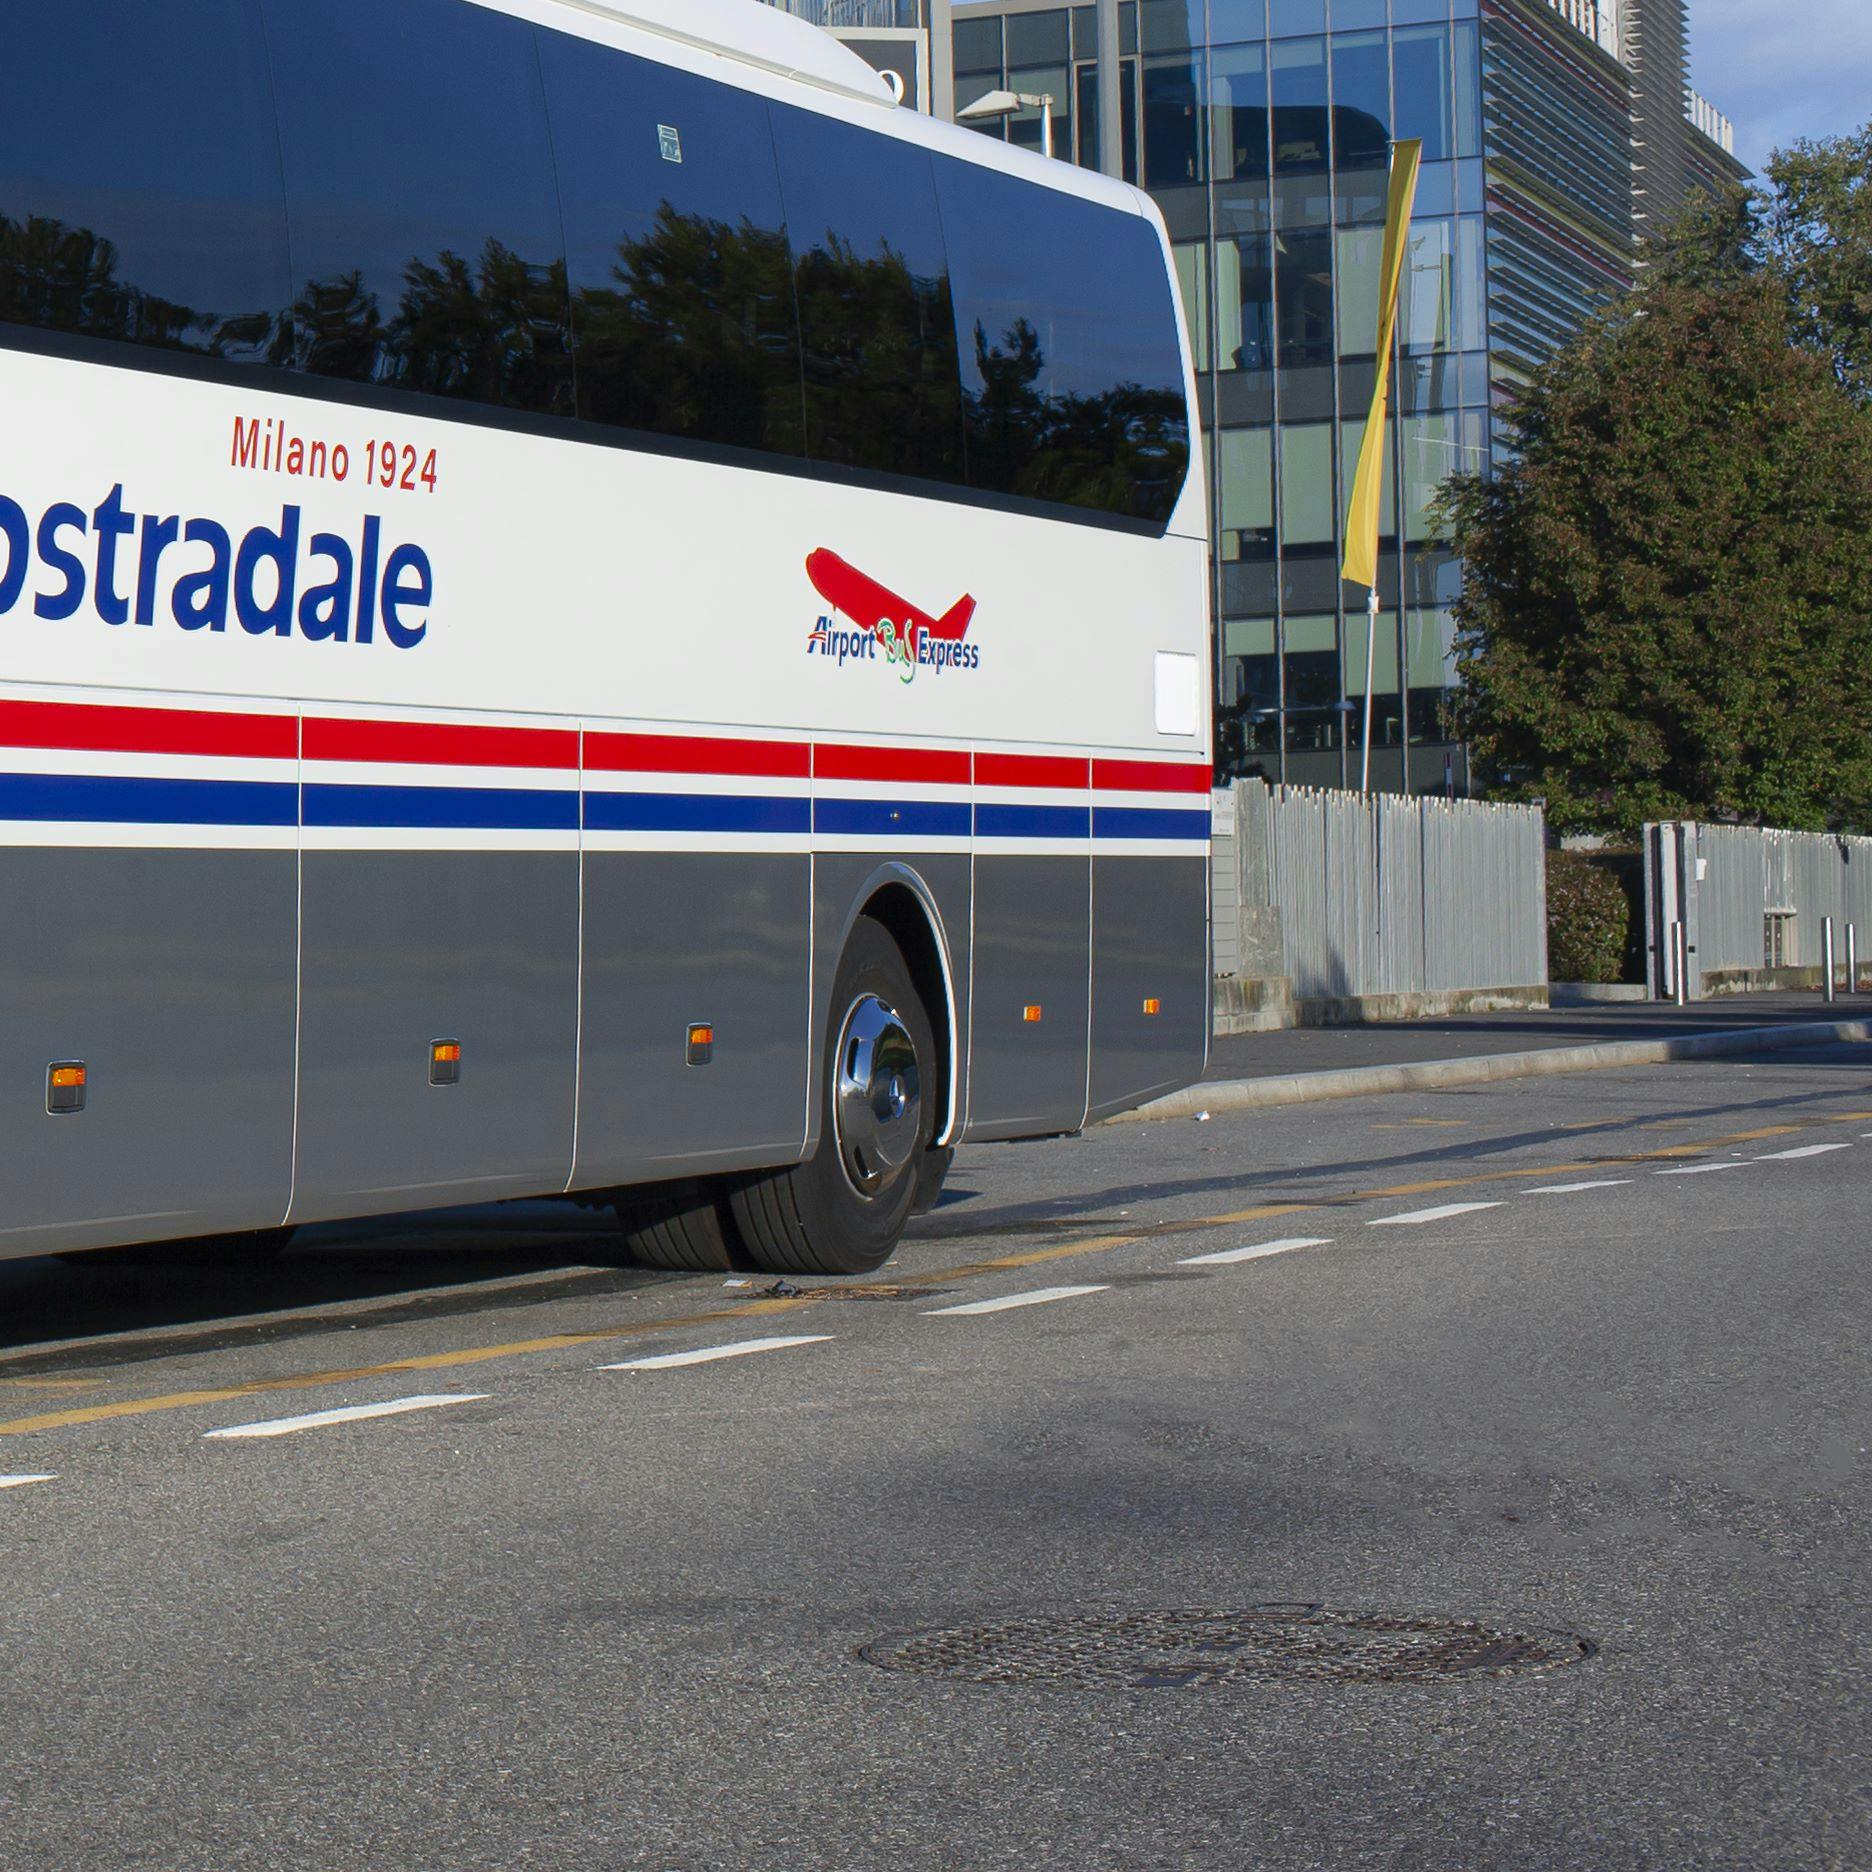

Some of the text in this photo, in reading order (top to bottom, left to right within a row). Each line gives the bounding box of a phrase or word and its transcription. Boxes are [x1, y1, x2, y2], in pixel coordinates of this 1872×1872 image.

[230, 415, 437, 494] Milano 1924
[807, 615, 979, 684] Airport Bus Express
